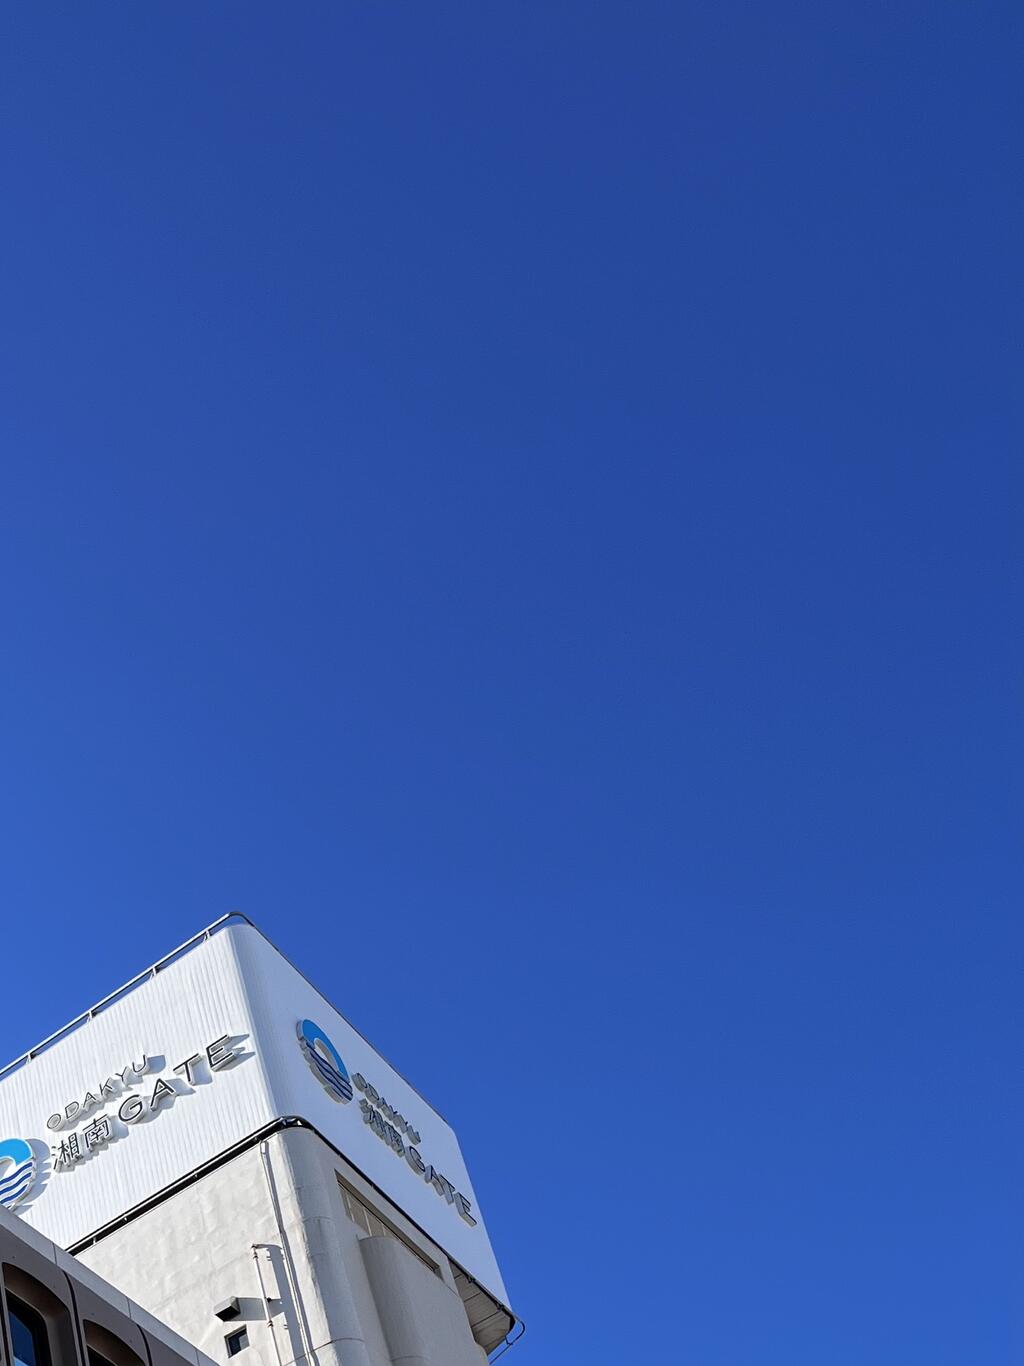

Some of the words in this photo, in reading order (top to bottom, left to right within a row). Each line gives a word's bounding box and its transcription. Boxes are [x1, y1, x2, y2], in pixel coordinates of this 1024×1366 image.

[46, 1054, 149, 1131] ODAKYU
[52, 1113, 110, 1171] 湘南
[118, 1034, 236, 1125] GATE
